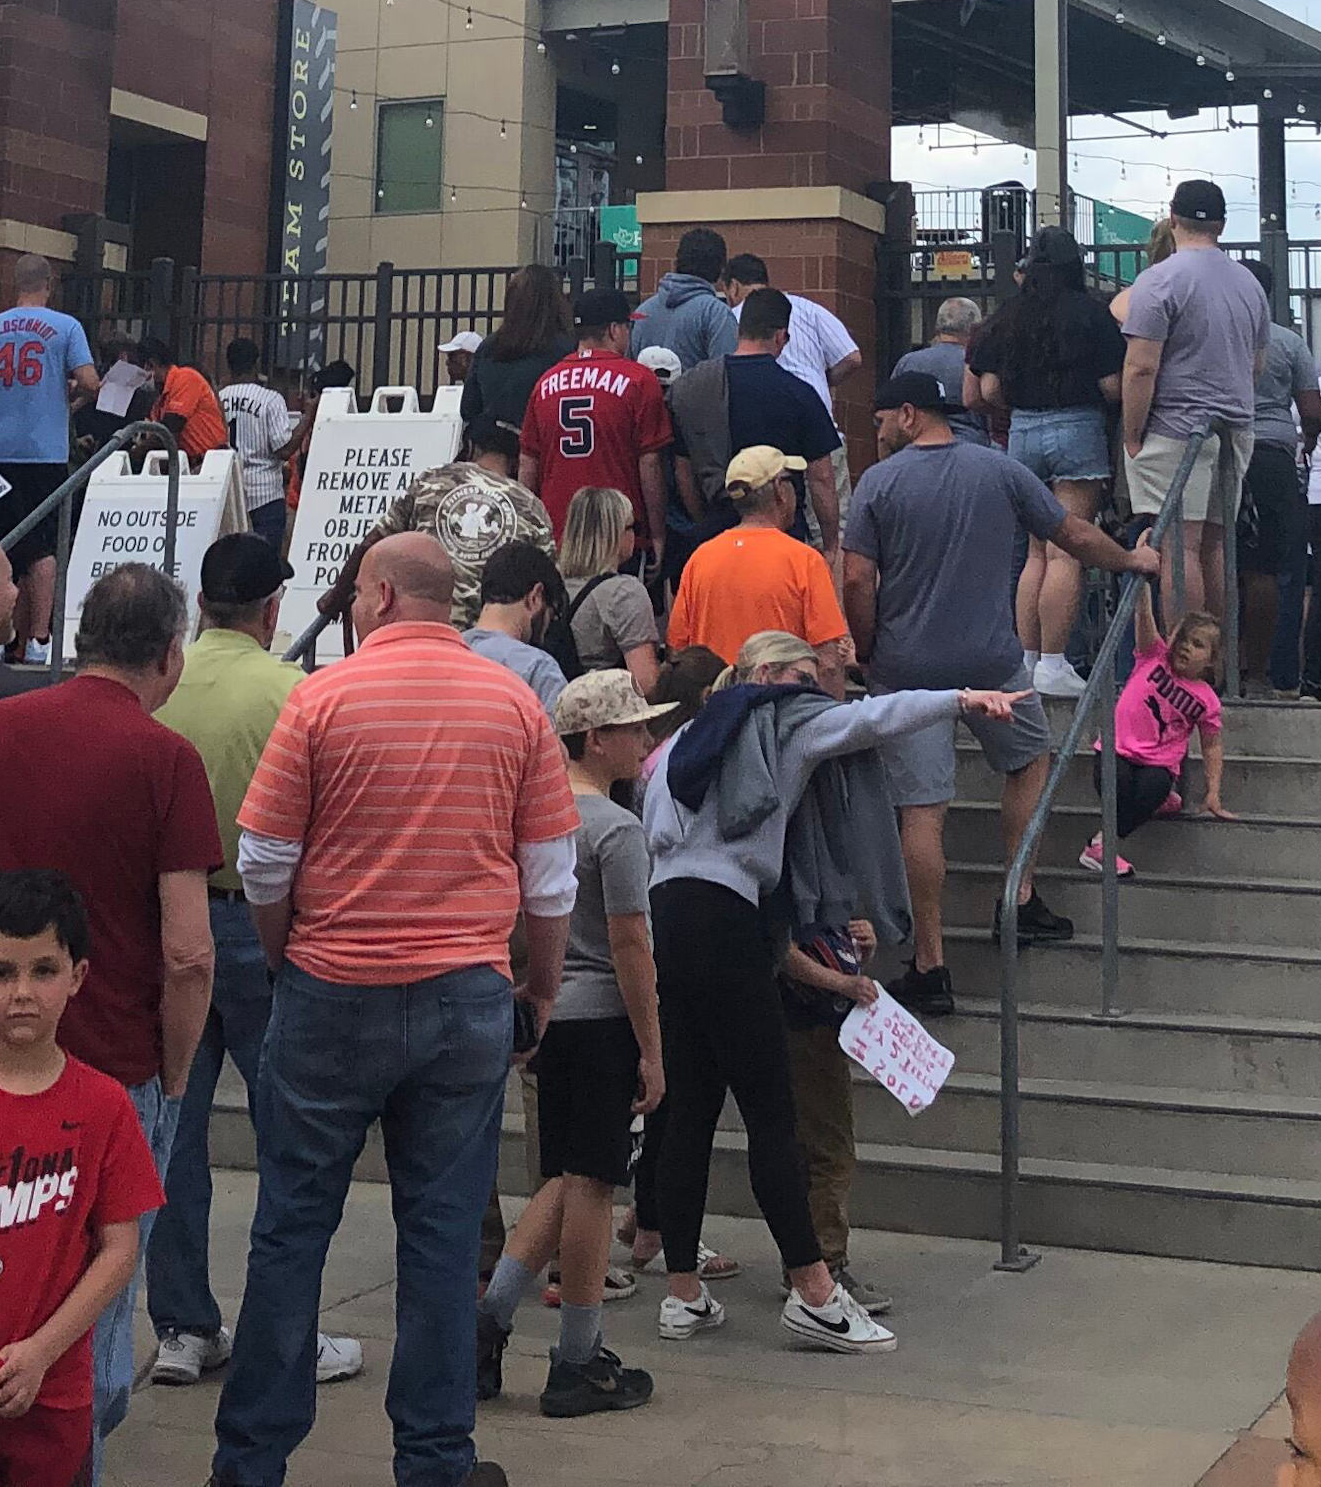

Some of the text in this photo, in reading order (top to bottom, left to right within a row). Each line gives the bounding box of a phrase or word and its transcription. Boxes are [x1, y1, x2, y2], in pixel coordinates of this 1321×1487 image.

[289, 27, 311, 181] STORE
[540, 366, 631, 400] FREEMAN
[559, 396, 595, 458] 5
[344, 448, 413, 467] PLEASE
[316, 471, 416, 491] REMOVE AL
[97, 511, 198, 527] NO OUTSDE
[324, 518, 374, 538] OBJE
[102, 536, 148, 552] FOOD
[1147, 664, 1207, 719] PUMA
